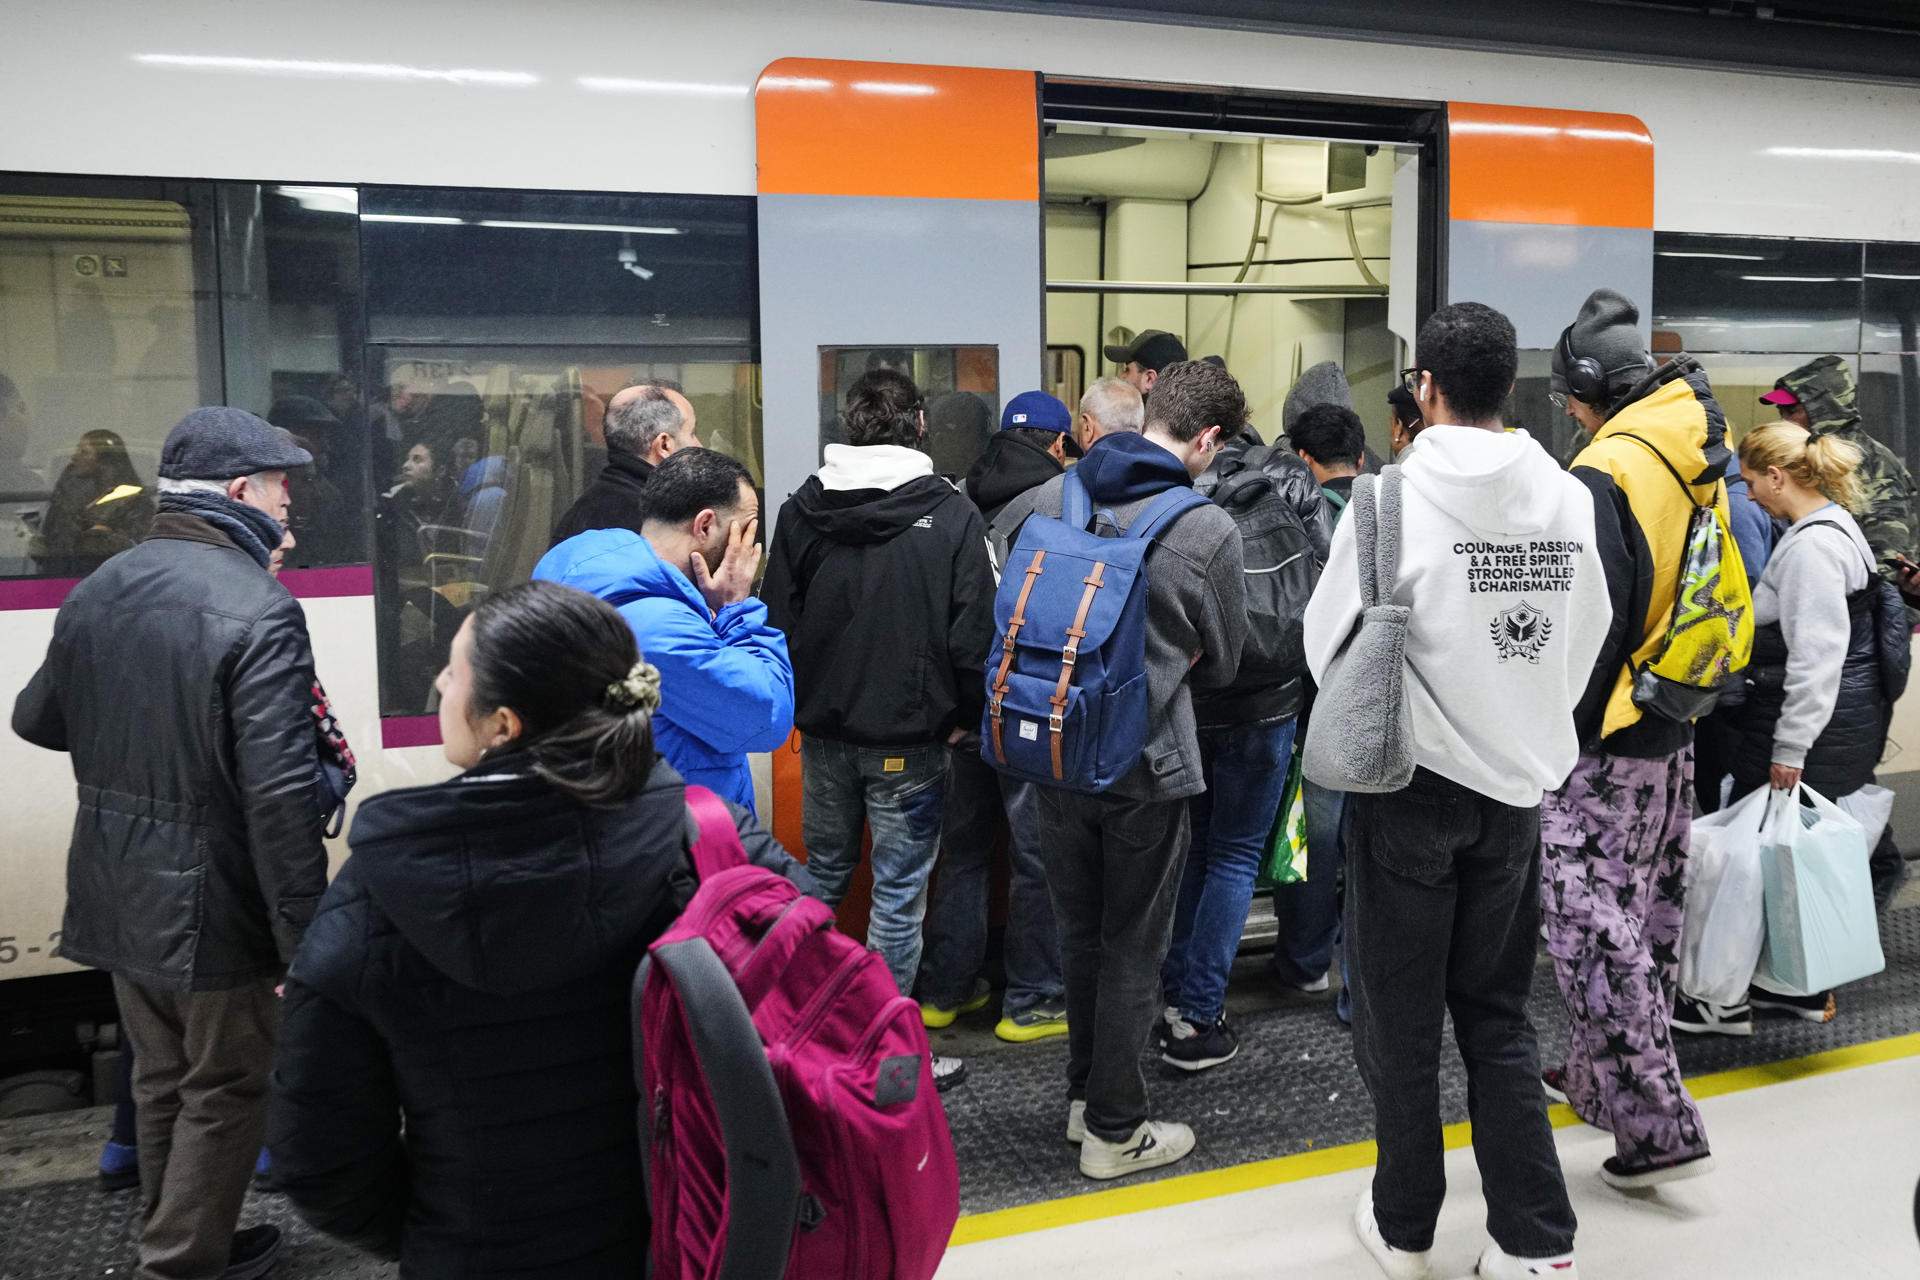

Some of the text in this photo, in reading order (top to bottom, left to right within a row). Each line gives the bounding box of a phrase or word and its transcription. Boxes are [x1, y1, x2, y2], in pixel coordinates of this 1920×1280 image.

[1453, 541, 1583, 555] COURAGE, PASSION
[1470, 554, 1573, 567] & A FREE SPIRIT.
[1467, 567, 1576, 580] STRONG-WILLED
